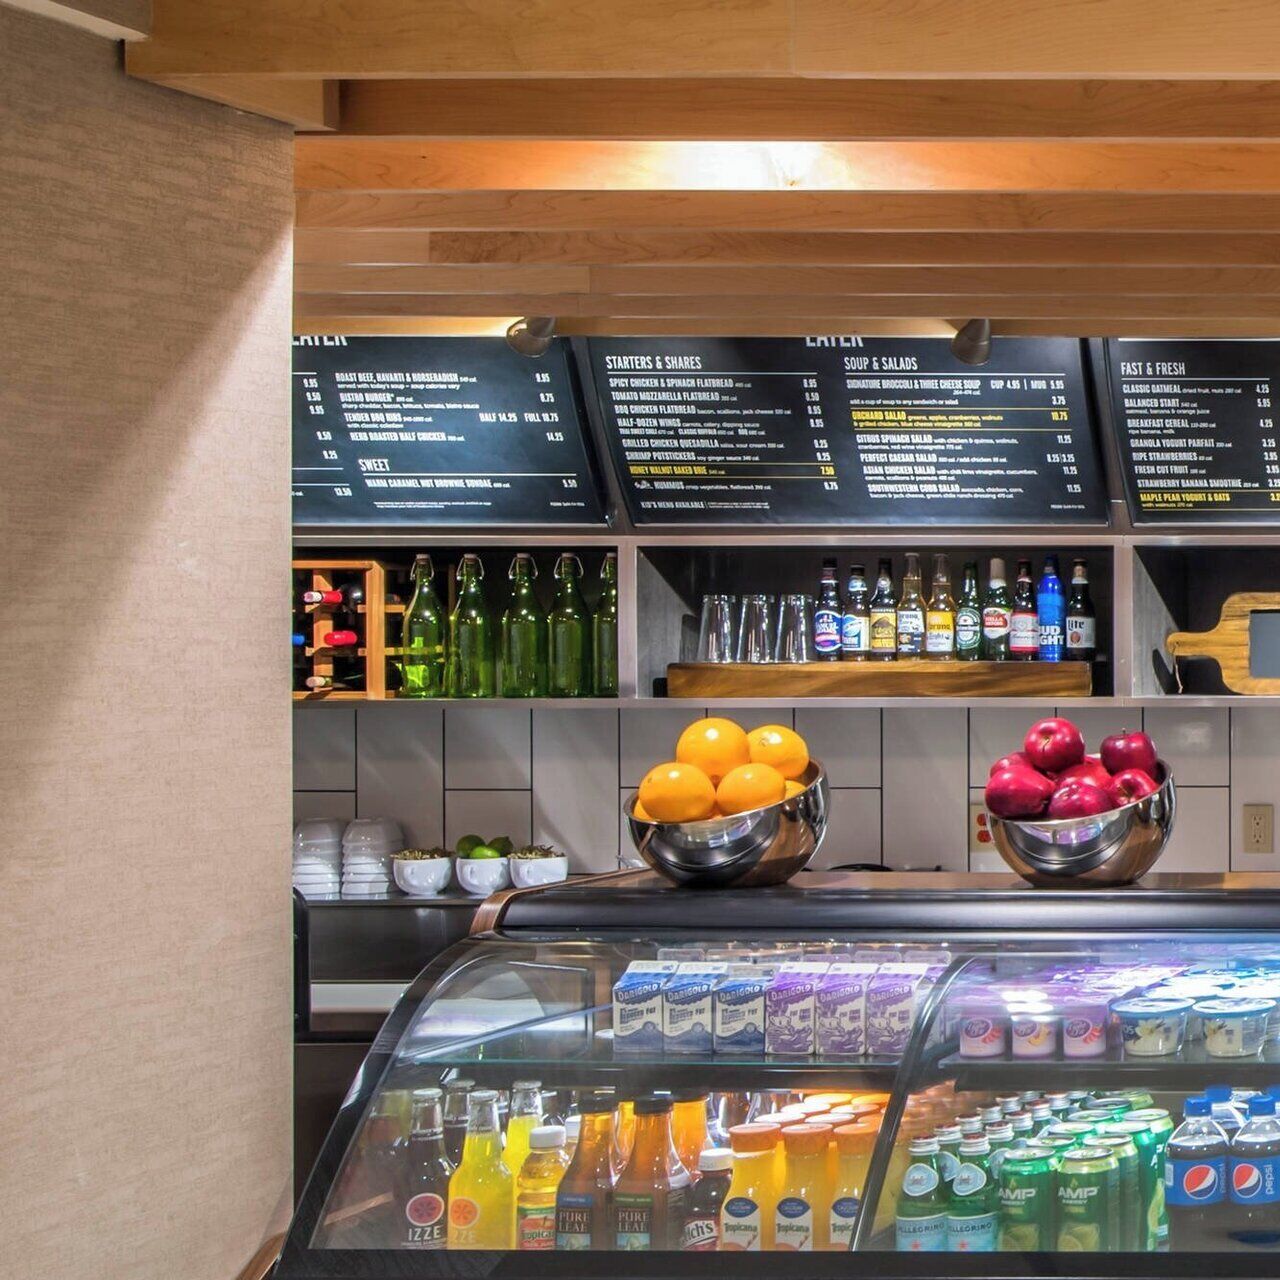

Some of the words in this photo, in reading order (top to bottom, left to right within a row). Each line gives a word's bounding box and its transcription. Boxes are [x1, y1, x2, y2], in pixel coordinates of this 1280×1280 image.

[606, 356, 652, 370] STARTERS
[656, 356, 662, 370] &
[665, 356, 702, 370] SHARES
[845, 358, 869, 370] SOUP
[873, 358, 879, 370] &
[882, 358, 918, 370] SALADS
[1121, 362, 1143, 375] FAST
[1146, 362, 1153, 375] &
[1156, 362, 1186, 375] FRESH
[610, 378, 629, 388] SPICY
[630, 379, 659, 388] CHICKEN
[358, 459, 390, 472] SWEET
[1040, 625, 1061, 635] UD
[1265, 1164, 1275, 1195] pepsi
[1058, 1187, 1098, 1199] AMP
[559, 1212, 591, 1222] PURE
[618, 1212, 648, 1222] PURE
[408, 1226, 441, 1241] IZZE
[724, 1222, 758, 1233] Tropicana
[776, 1222, 810, 1233] Tropicana
